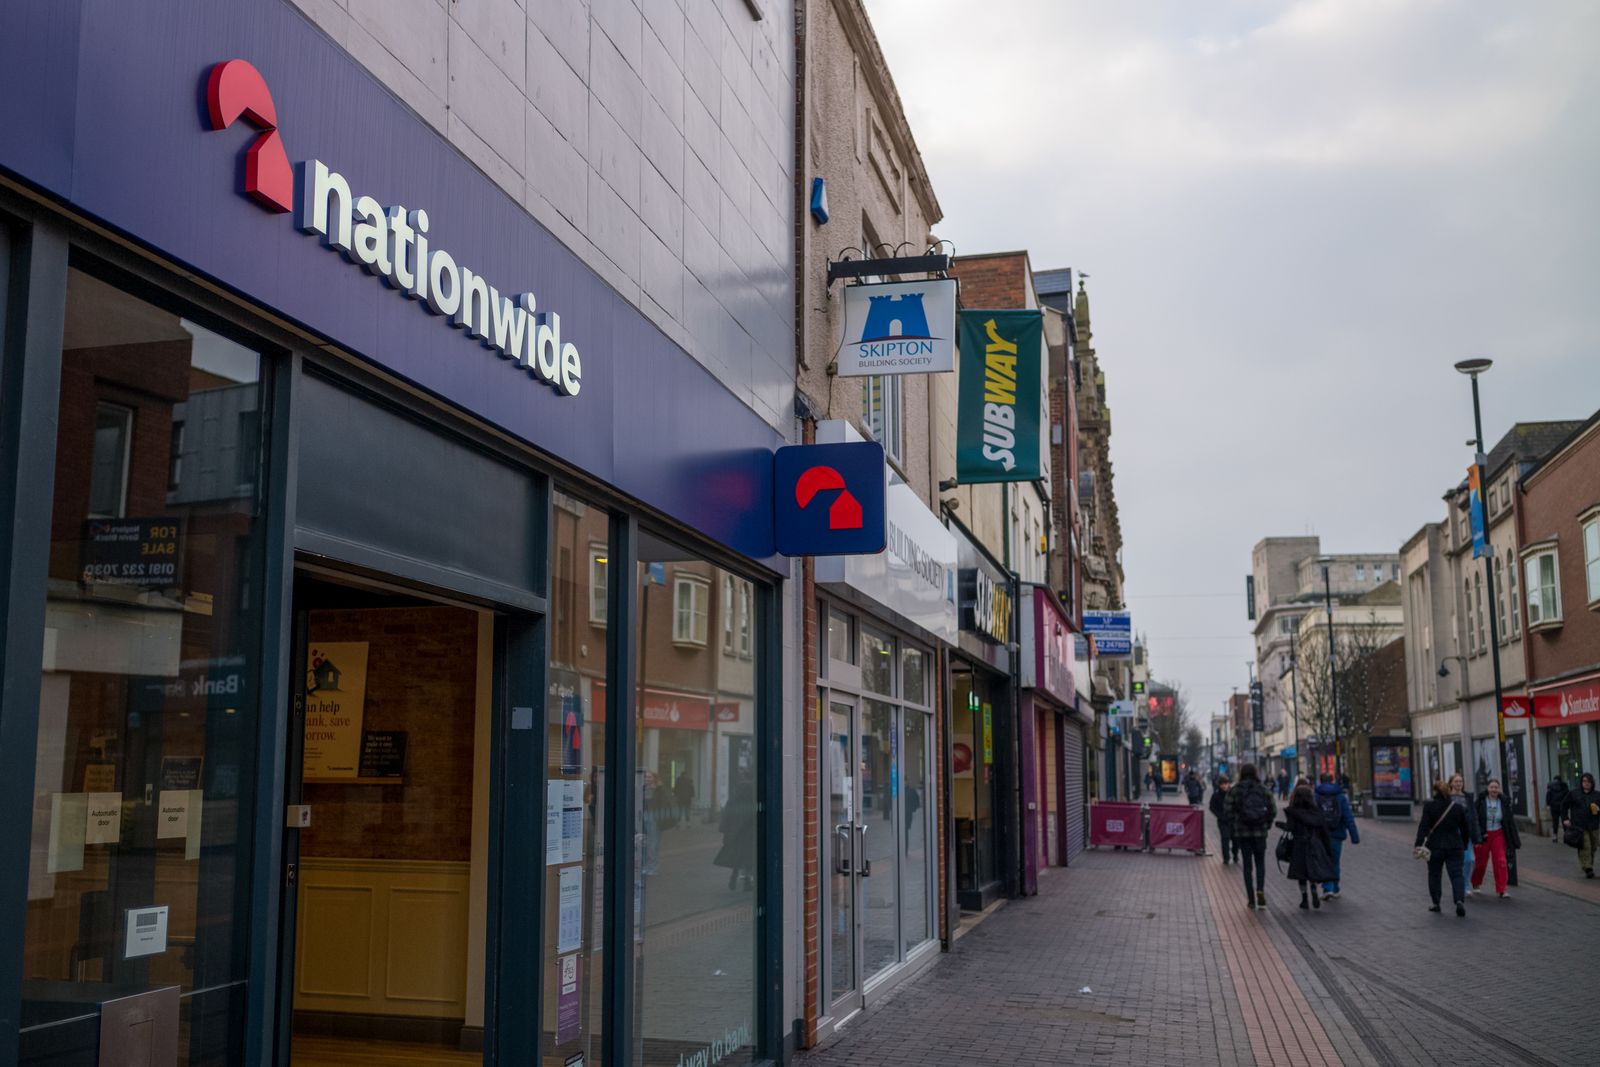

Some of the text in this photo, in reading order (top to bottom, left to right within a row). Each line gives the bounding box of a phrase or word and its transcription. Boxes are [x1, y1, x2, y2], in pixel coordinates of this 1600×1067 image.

[303, 159, 582, 396] nationwide
[859, 340, 933, 358] SKIPTON
[858, 357, 932, 368] BUILDING SOCIETY
[982, 318, 1018, 472] SUBWAY
[888, 520, 945, 592] BUILDING SOCIETY
[974, 568, 1012, 646] SUBWAY
[319, 699, 340, 715] help
[1568, 689, 1600, 716] Santander
[306, 714, 351, 728] ank, save
[306, 731, 336, 741] orrow.
[91, 809, 118, 817] Automatic
[162, 806, 185, 814] Automatic
[711, 1038, 723, 1065] to
